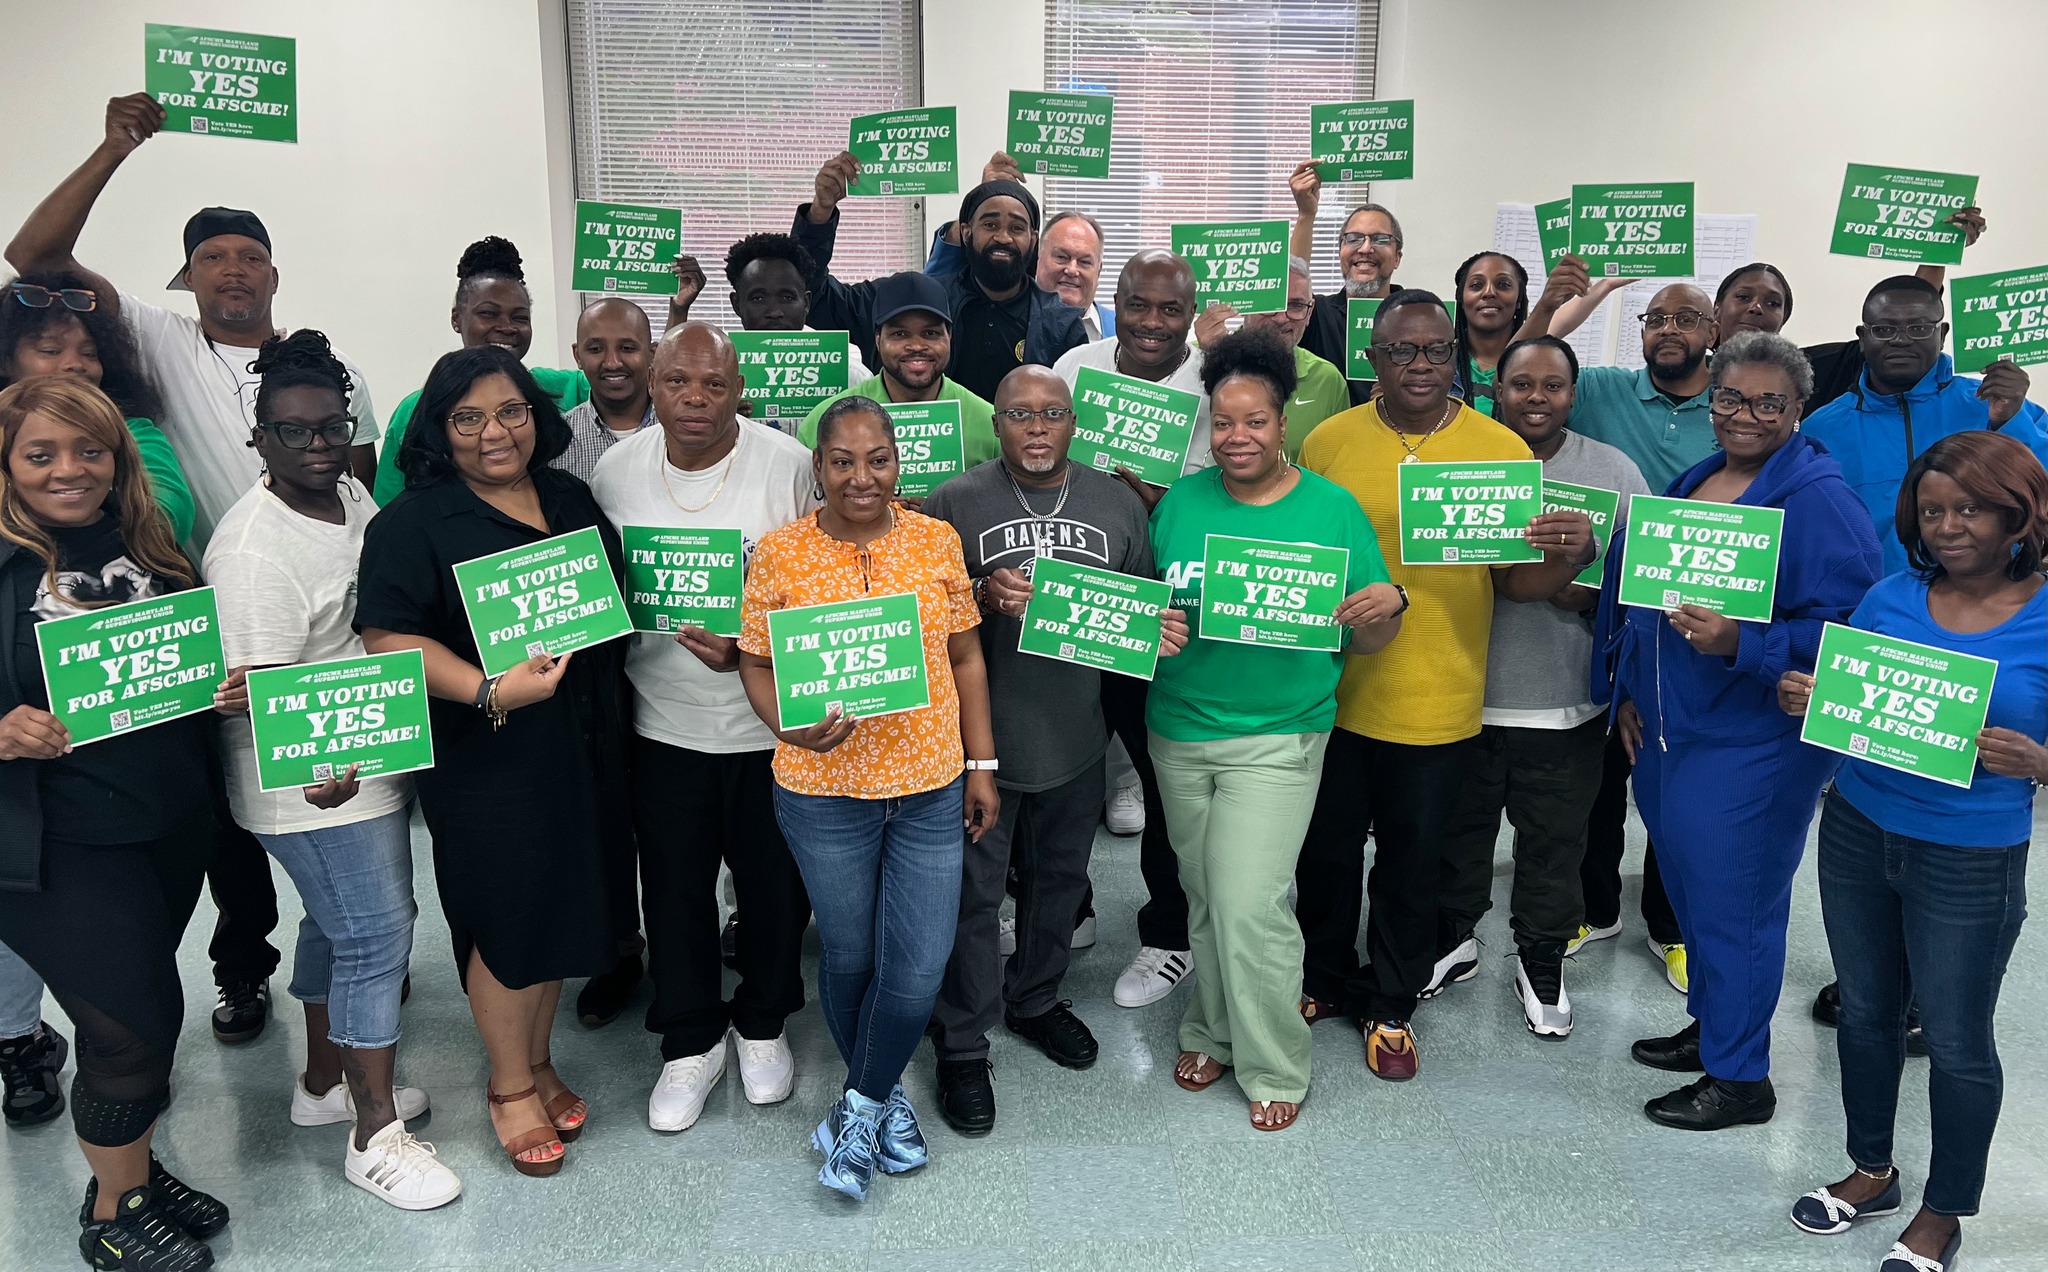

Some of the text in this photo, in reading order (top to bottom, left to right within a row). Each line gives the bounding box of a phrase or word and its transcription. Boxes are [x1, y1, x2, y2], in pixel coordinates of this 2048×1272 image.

[157, 48, 288, 75] I'M VOTING
[190, 70, 259, 98] YES
[157, 92, 289, 116] FOR AFSCME!
[1016, 109, 1106, 126] I'M VOTING
[1319, 118, 1408, 133] I'M VOTING
[856, 126, 951, 144] I'M VOTING
[1038, 124, 1086, 145] YES
[1341, 133, 1388, 151] YES
[879, 141, 929, 161] YES
[1014, 142, 1105, 157] FOR AFSCME!
[1319, 150, 1408, 164] FOR AFSCME!
[888, 160, 953, 174] AFSCME!
[1851, 185, 1966, 208] I'M VOTING
[1546, 215, 1570, 231] I'M
[1579, 204, 1687, 219] I'M VOTING
[1875, 203, 1938, 228] YES
[584, 221, 676, 240] I'M VOTING
[1605, 221, 1662, 242] YES
[1843, 222, 1958, 244] FOR AFSCME!
[607, 239, 656, 260] YES
[1181, 241, 1282, 257] I'M VOTING
[1579, 243, 1687, 255] FOR AFSCME!
[582, 258, 611, 270] FOR
[1206, 258, 1260, 279] YES
[1195, 278, 1282, 293] OR AFSCME!
[1963, 287, 2048, 313] I'M VOT
[1964, 335, 2004, 350] FOR
[739, 352, 842, 364] I'M VOTING
[765, 367, 820, 385] YES
[740, 388, 771, 398] FOR
[1082, 389, 1188, 427] I'M VOTING
[894, 423, 954, 439] OTING
[1103, 411, 1161, 443] YES
[895, 440, 931, 461] ES
[1072, 427, 1179, 462] FOR AFSCME!
[899, 460, 957, 475] FSCME!
[1411, 486, 1534, 501] I'M VOTING
[1441, 504, 1506, 525] YES
[1004, 523, 1087, 549] RAVENS
[1413, 527, 1525, 539] FOR AFSCME
[1639, 521, 1770, 549] I'M VOTING
[631, 551, 735, 567] I'M VOTING
[1668, 543, 1738, 573] YES
[476, 553, 599, 602] I'M VOTING
[654, 569, 709, 594] YES
[1215, 560, 1337, 587] I'M VOTING
[1634, 564, 1766, 592] FOR AFSCME!
[511, 579, 580, 620] YES
[632, 592, 736, 610] FOR AFSCME!
[1042, 580, 1159, 617] I'M VOTING
[1244, 581, 1308, 609] YES
[489, 595, 612, 645] FOR AFSCME!
[1066, 602, 1131, 633] YES
[1213, 602, 1333, 627] FOR AFSCME!
[59, 615, 209, 665] I'M VOTING
[786, 620, 912, 652] I'M VOTING
[1034, 618, 1152, 652] FOR AFSCME!
[100, 643, 180, 686] YES
[819, 643, 887, 676] YES
[1880, 651, 1947, 671] SUPERVISORS UNION
[1881, 647, 1949, 667] AFSCME MARYLAND
[68, 662, 215, 713] FOR AFSCME!
[791, 665, 917, 698] FOR AFSCME!
[1830, 654, 1978, 704] I'M VOTING
[267, 678, 416, 714] I'M VOTING
[1859, 682, 1939, 724] YES
[306, 703, 385, 738] YES
[1820, 701, 1968, 752] FOR AFSCME!
[272, 724, 421, 761] FOR AFSCME!
